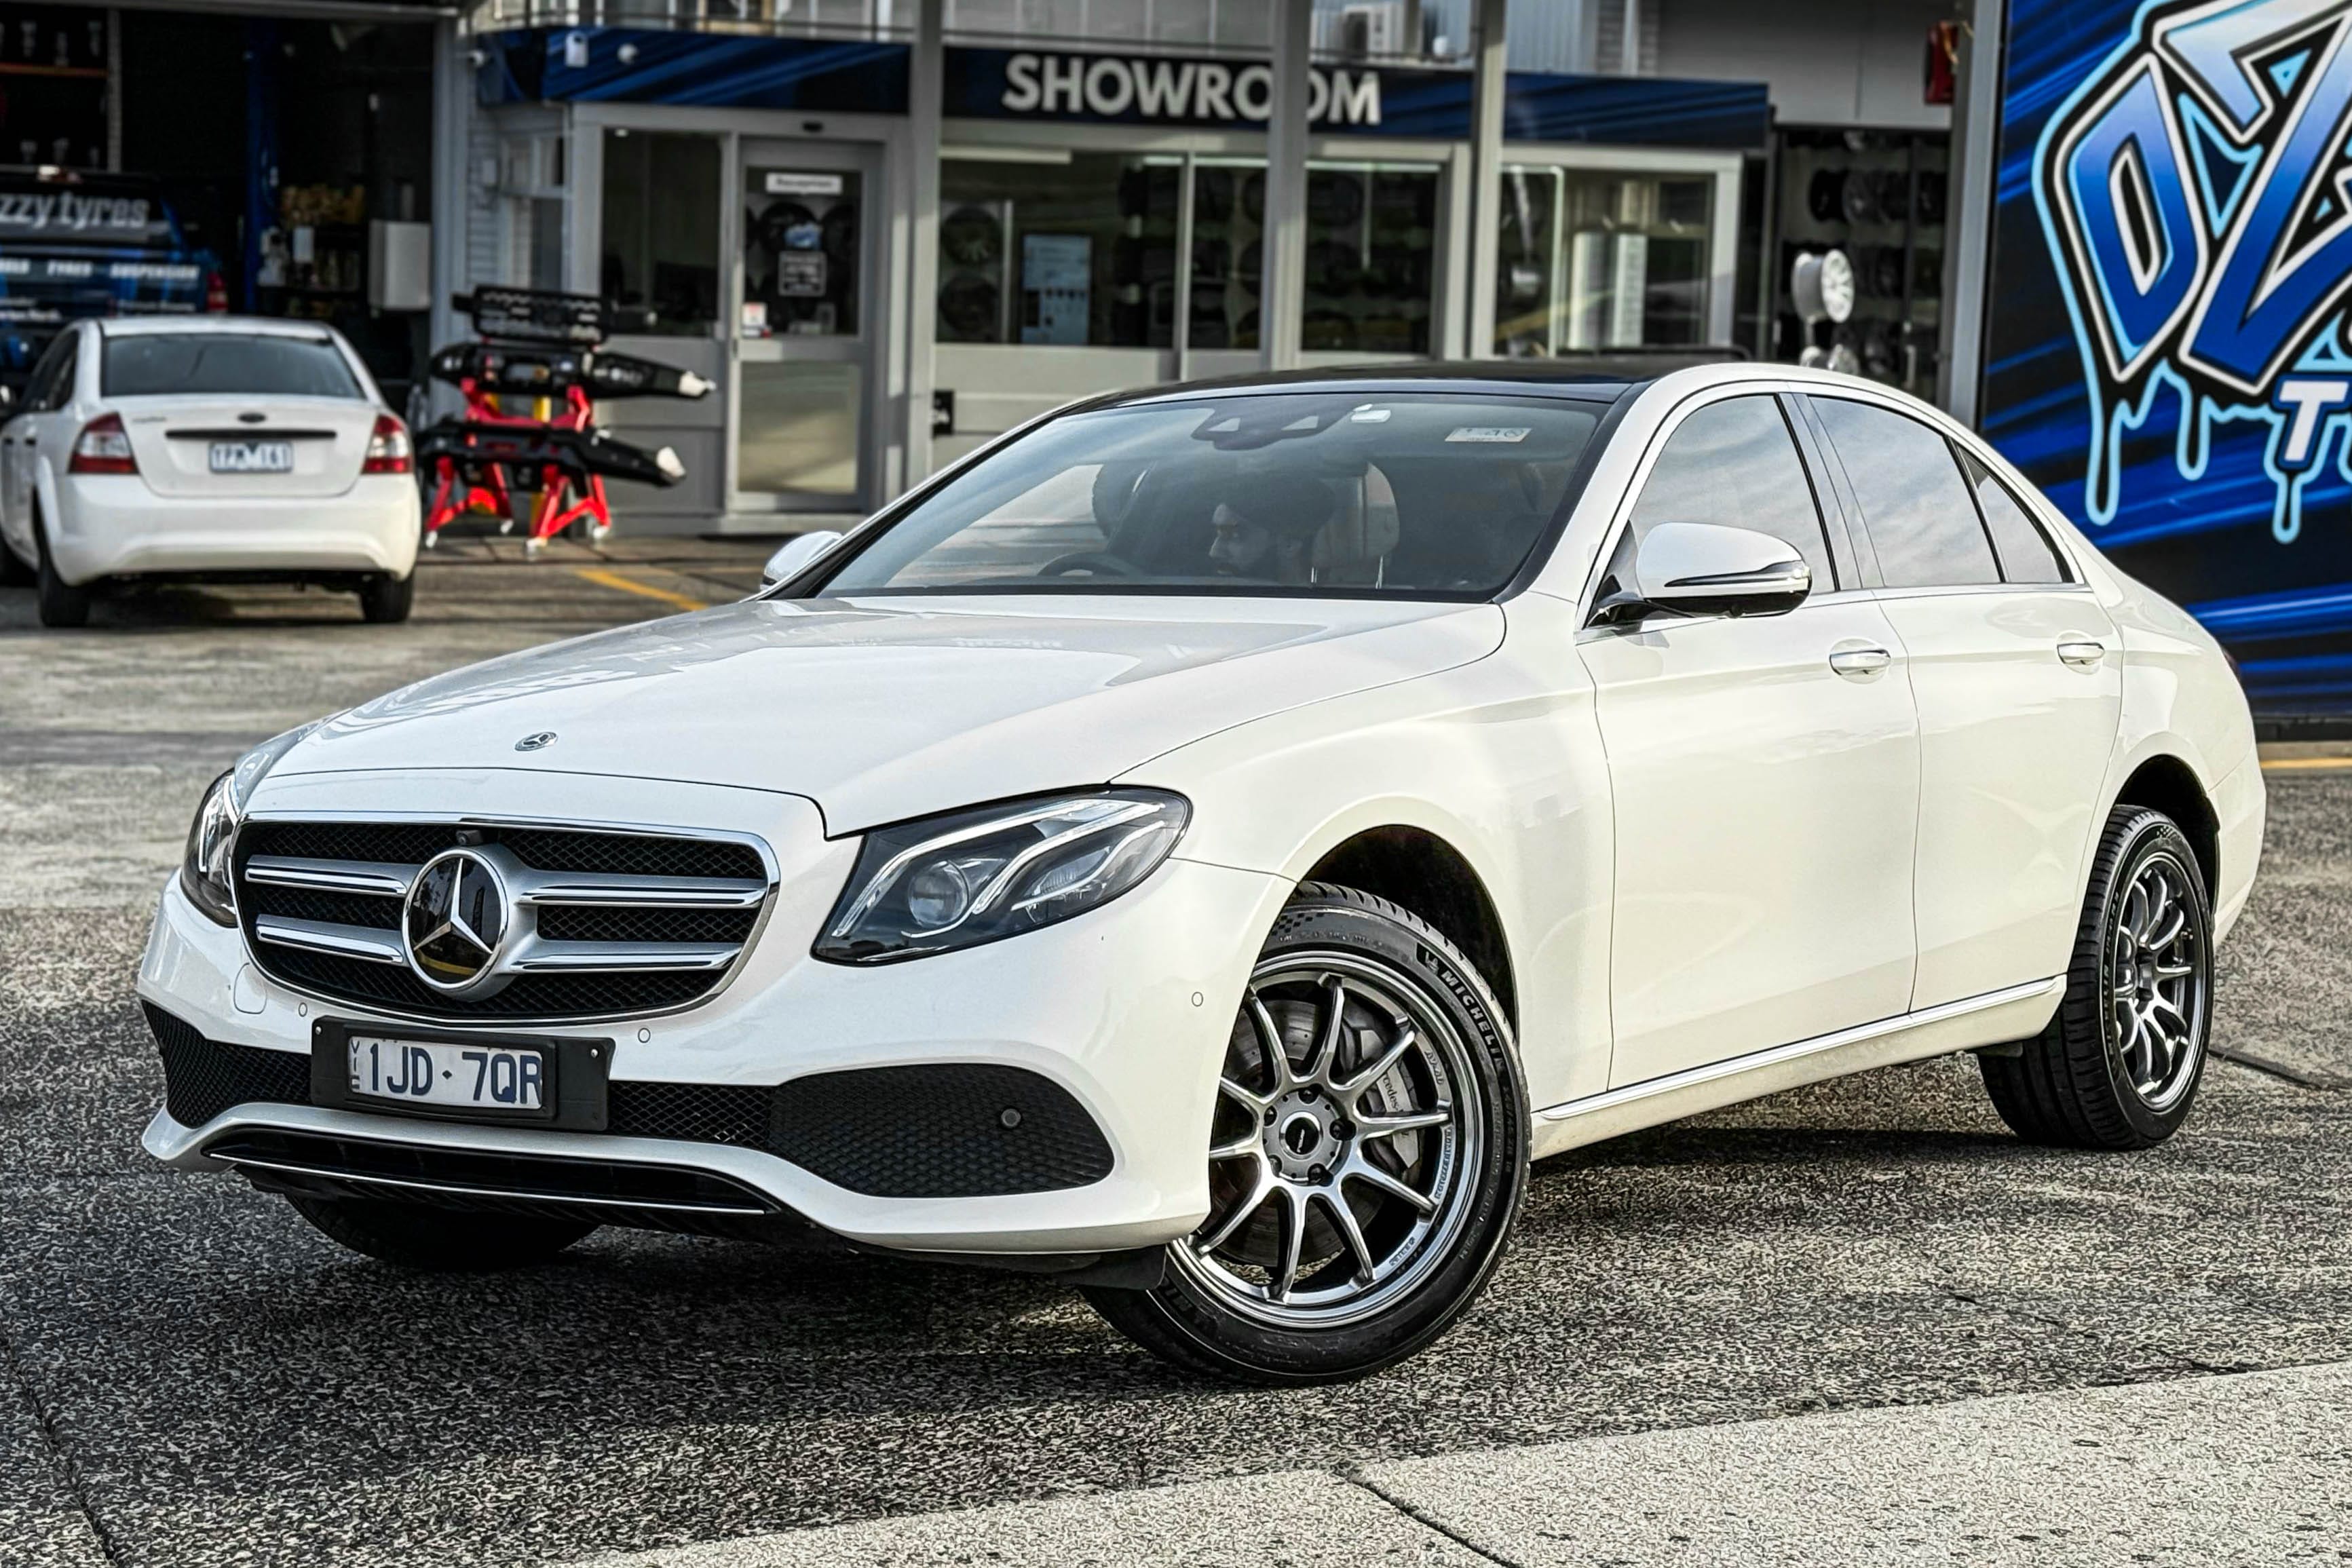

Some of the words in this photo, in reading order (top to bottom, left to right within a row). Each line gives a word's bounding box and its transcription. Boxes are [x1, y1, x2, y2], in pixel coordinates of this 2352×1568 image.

[58, 191, 149, 230] tyres
[2053, 0, 2352, 395] OZ
[1441, 970, 1504, 1071] MICHELIN
[370, 1043, 434, 1096] 1JD
